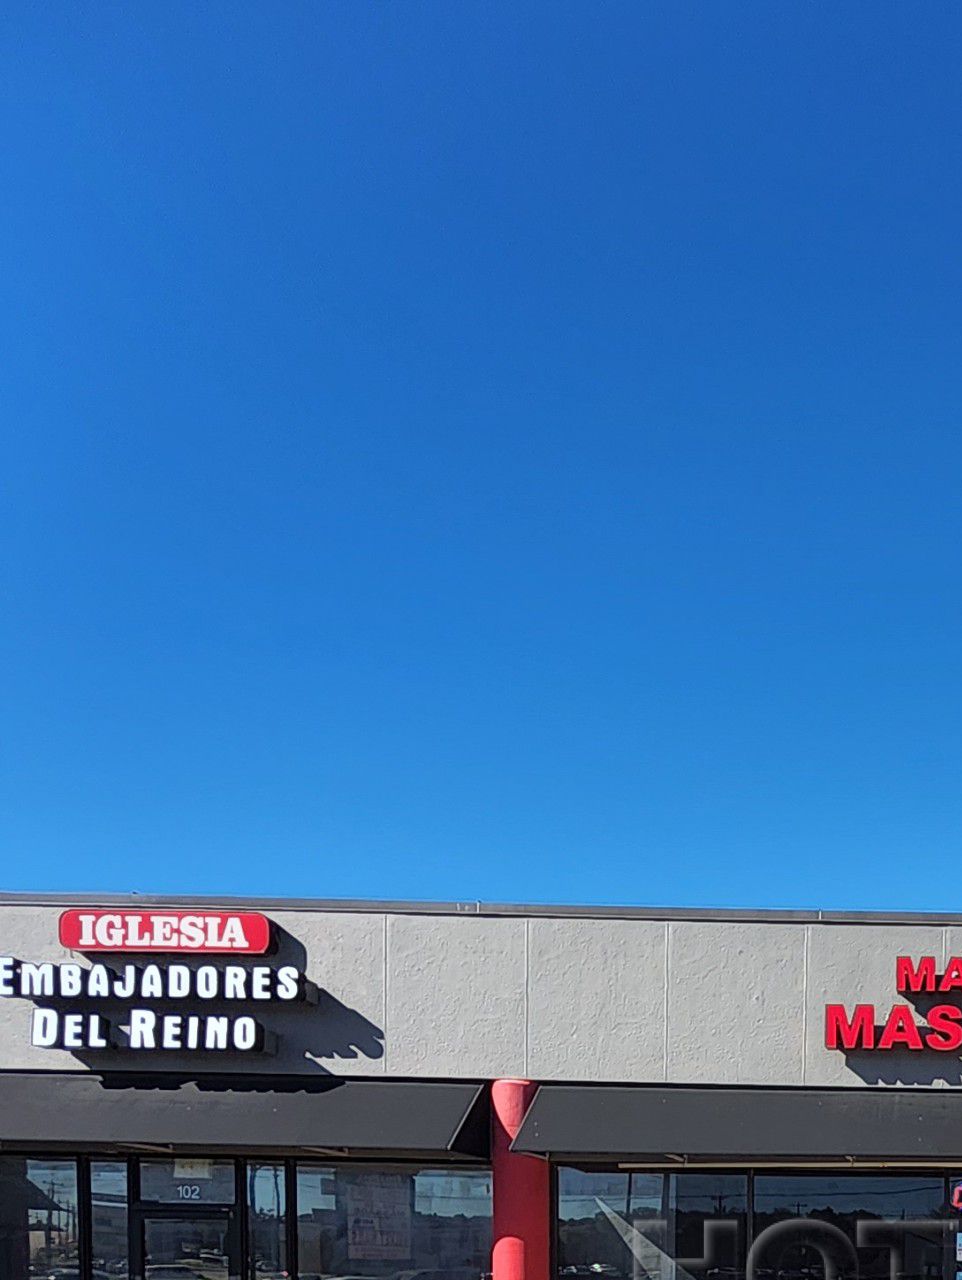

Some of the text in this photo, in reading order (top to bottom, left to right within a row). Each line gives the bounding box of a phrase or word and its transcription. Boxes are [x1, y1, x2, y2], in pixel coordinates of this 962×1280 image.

[79, 914, 249, 948] IGLESIA
[0, 957, 299, 1000] EMBAJADORES
[31, 1007, 257, 1051] DEL REINO
[176, 1184, 201, 1200] 102
